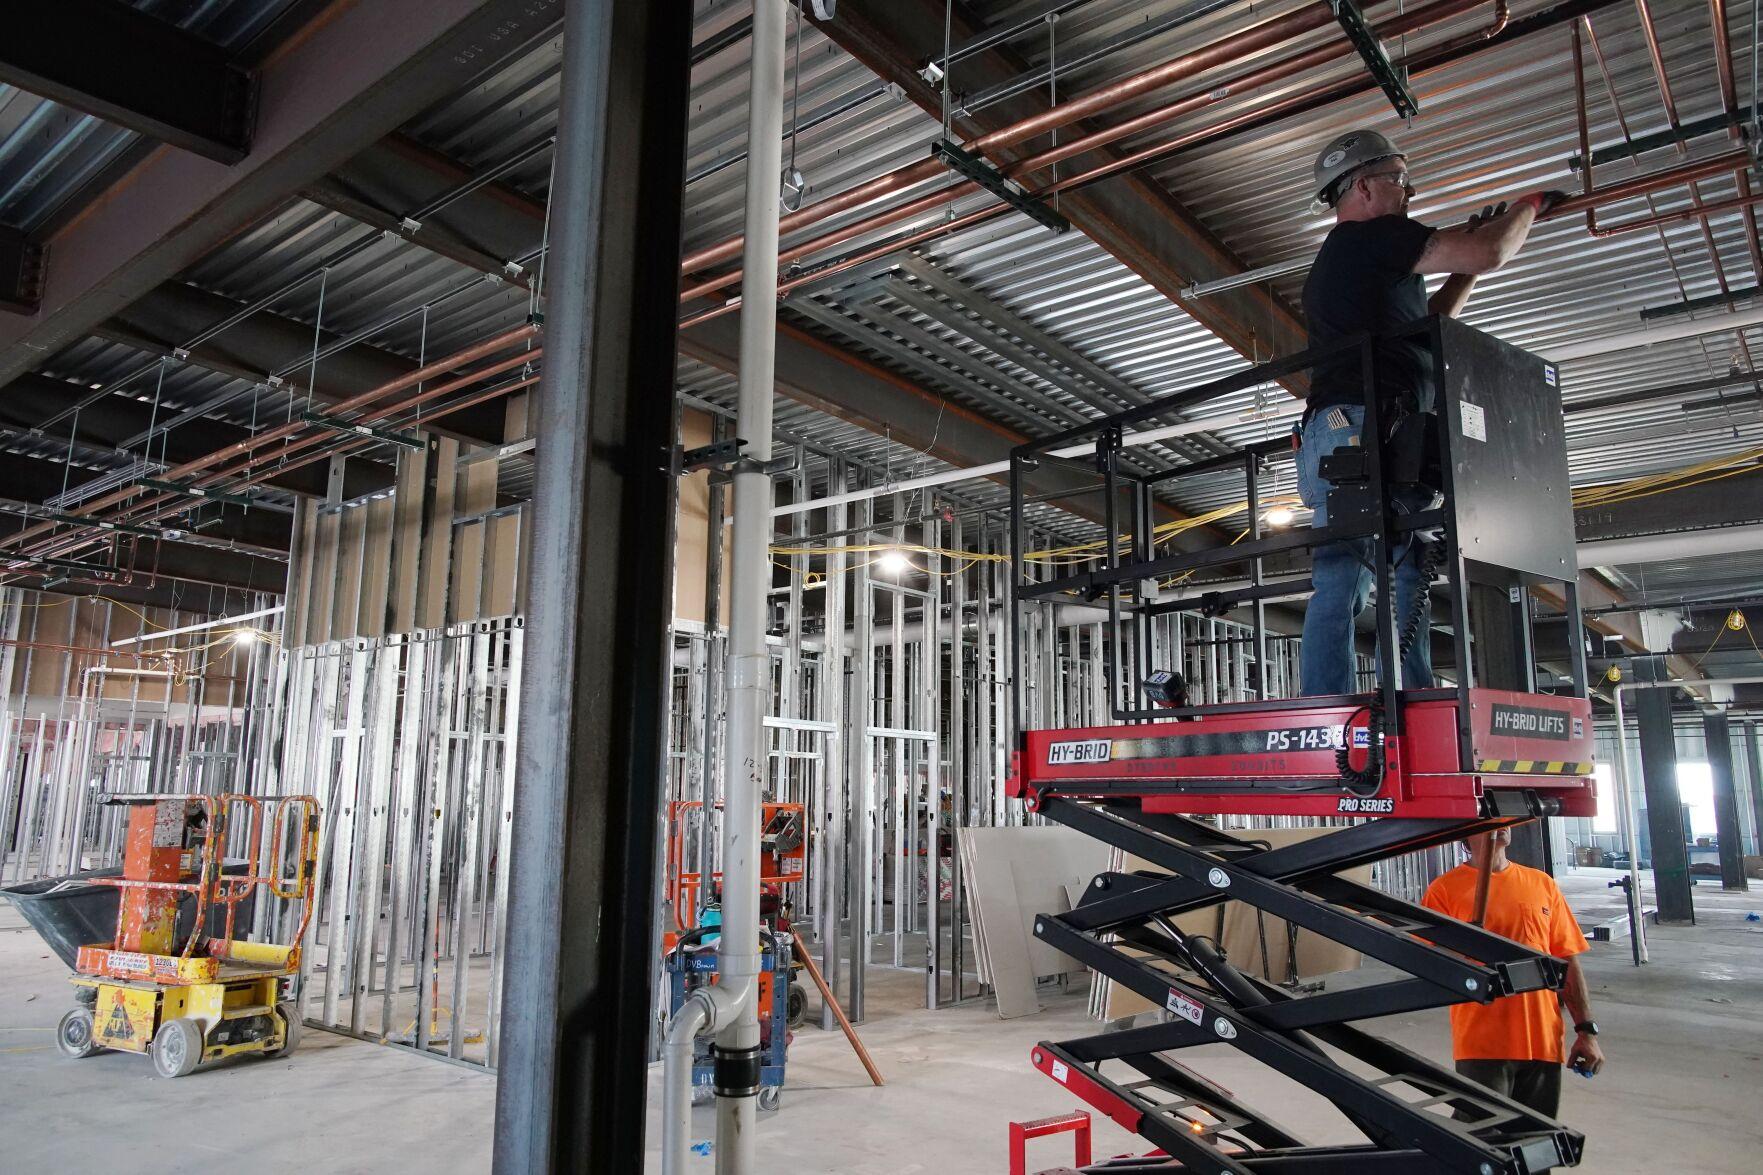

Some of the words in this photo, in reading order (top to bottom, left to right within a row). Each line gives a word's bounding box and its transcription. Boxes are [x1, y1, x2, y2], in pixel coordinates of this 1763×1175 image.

[1495, 711, 1537, 731] HY-BRID
[1538, 715, 1564, 734] LIFTS
[1050, 742, 1109, 762] HY-BRID
[1338, 798, 1359, 812] PRO
[1359, 799, 1395, 813] SERIES
